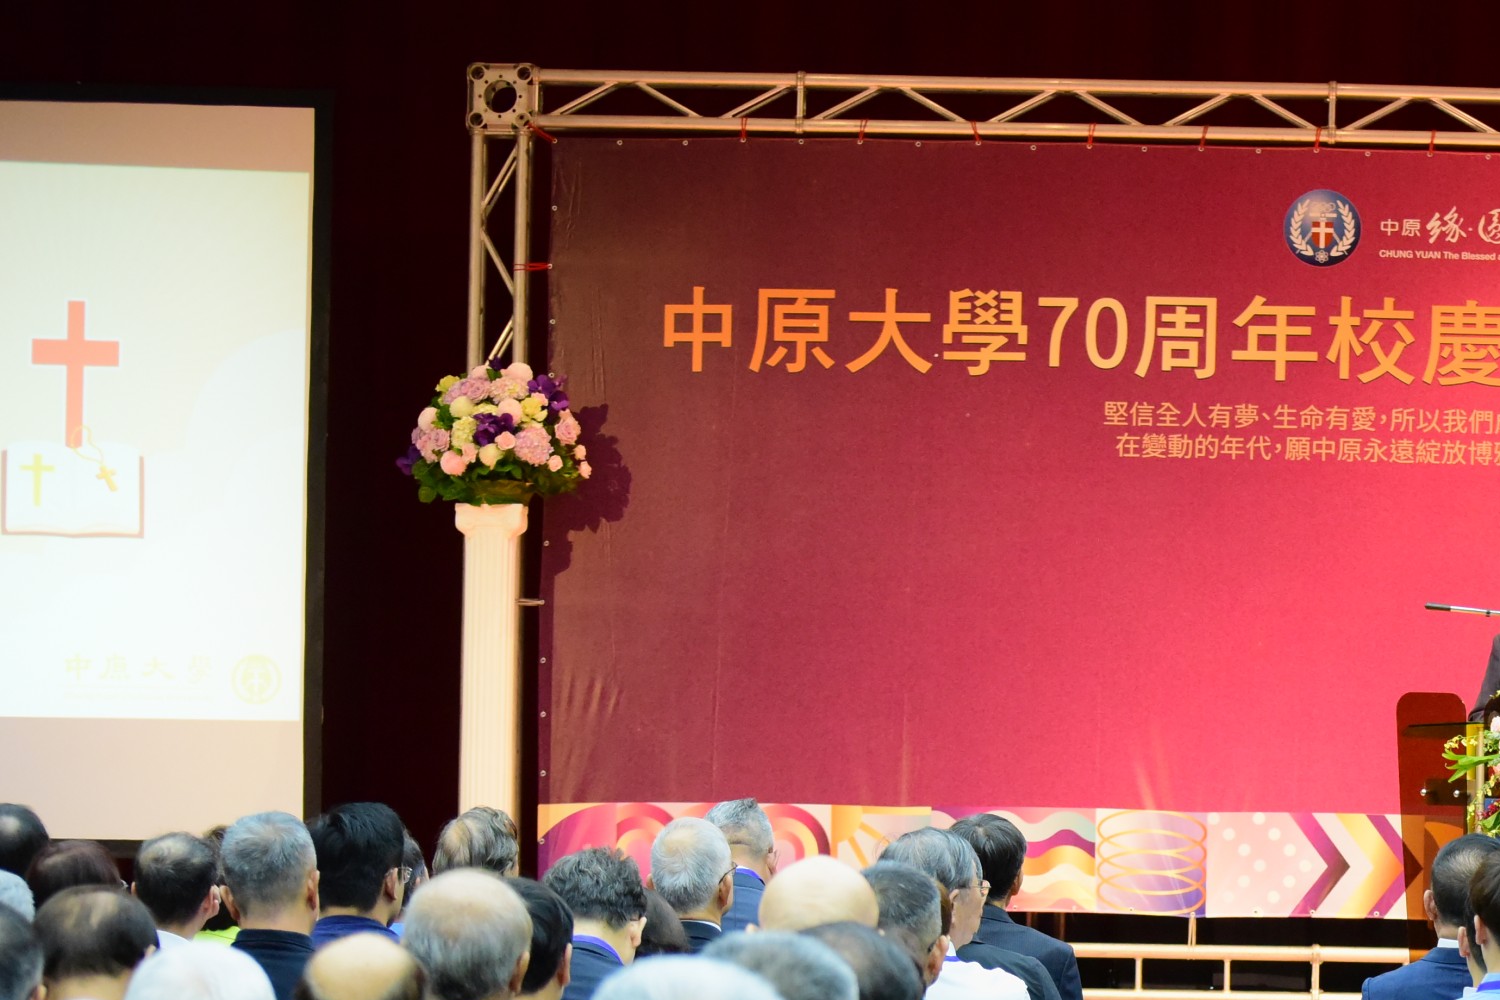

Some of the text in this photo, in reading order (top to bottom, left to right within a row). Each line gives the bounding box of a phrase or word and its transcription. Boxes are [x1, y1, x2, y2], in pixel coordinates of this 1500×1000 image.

[1379, 249, 1414, 259] CHUNG
[1415, 250, 1441, 260] YUAN
[1443, 251, 1460, 260] The
[1461, 252, 1496, 261] Blessed
